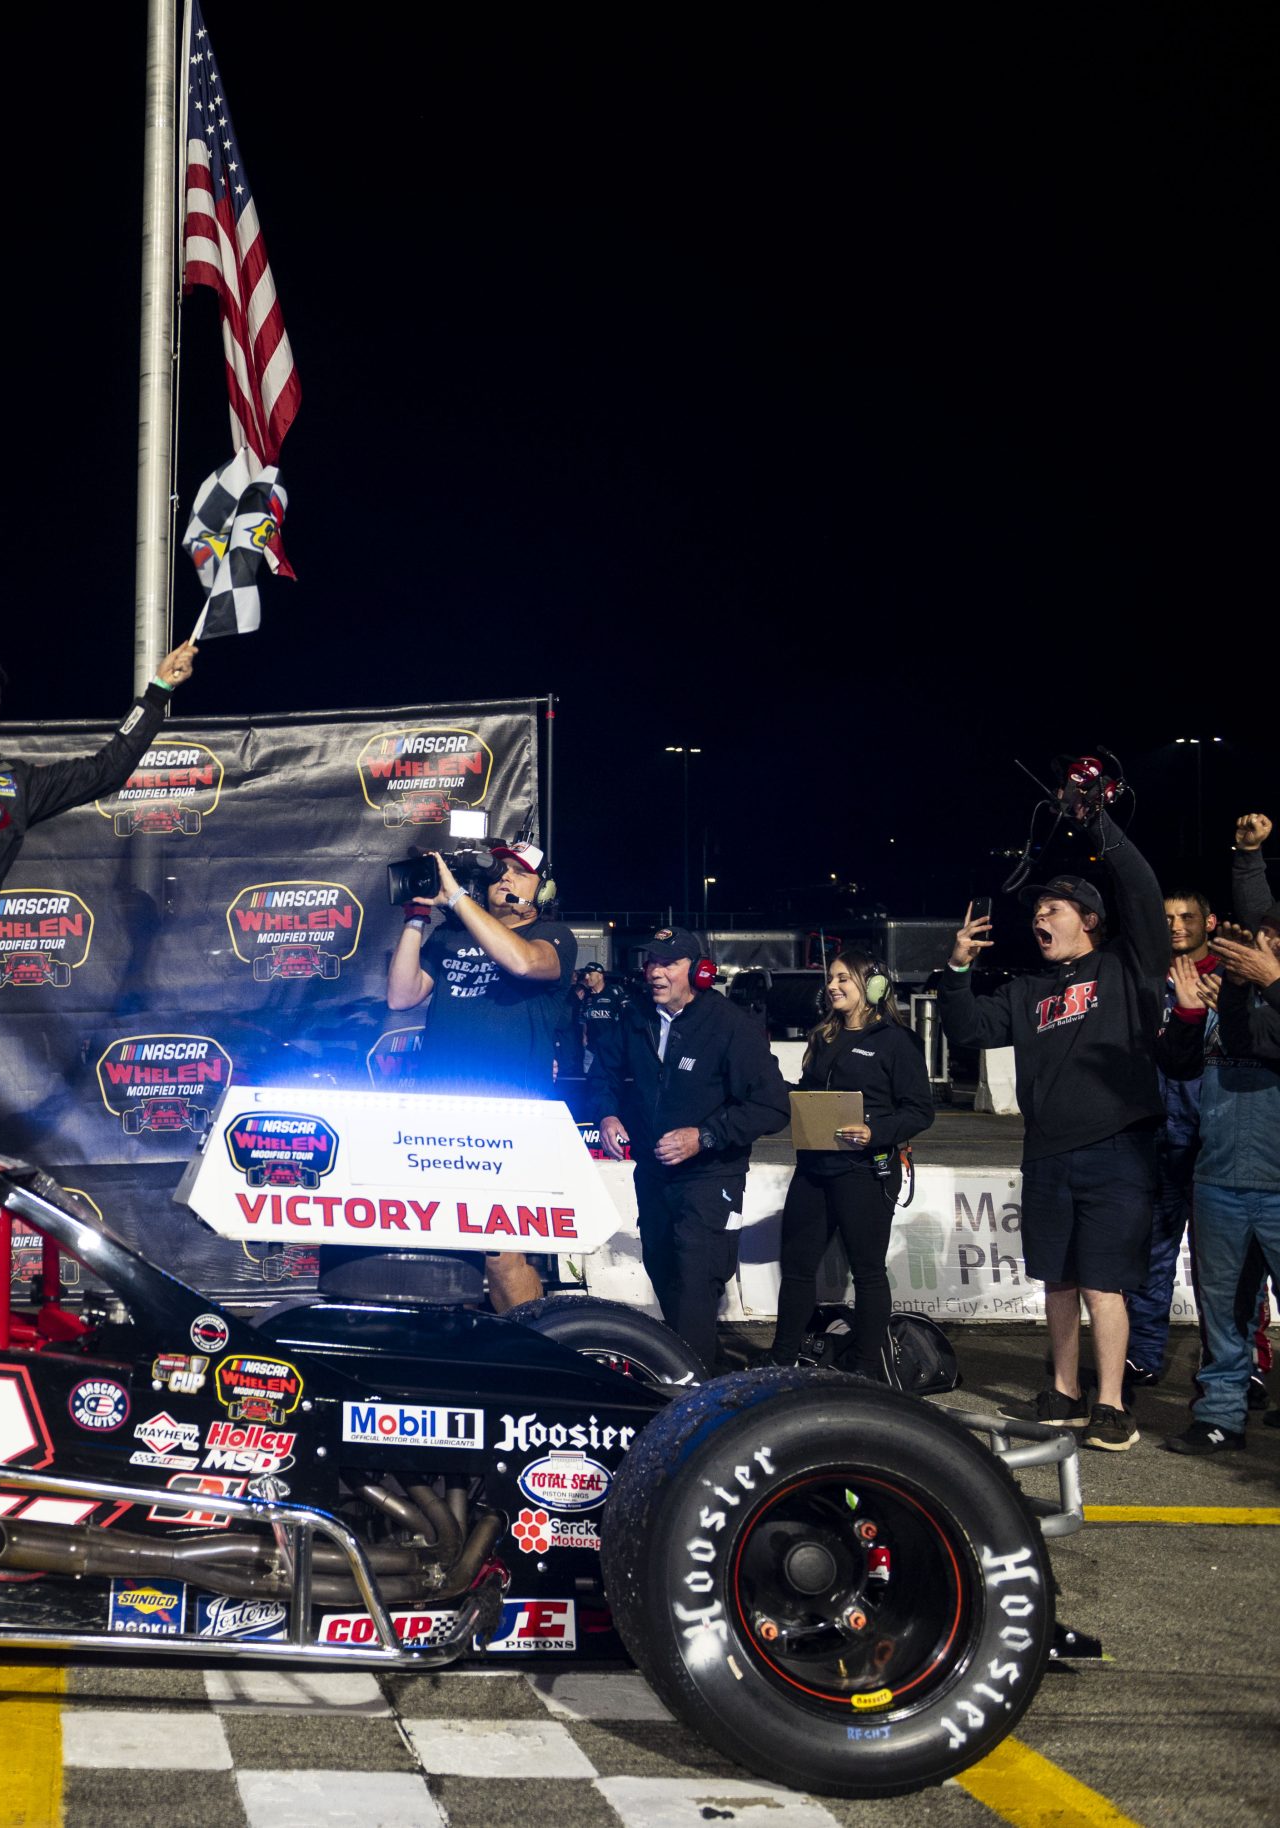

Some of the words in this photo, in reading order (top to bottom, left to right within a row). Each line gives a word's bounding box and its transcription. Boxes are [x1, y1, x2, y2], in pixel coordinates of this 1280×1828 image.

[401, 736, 469, 754] NASCAR
[367, 751, 482, 778] WHELEN
[387, 779, 437, 790] MODIFIED
[439, 777, 465, 788] TOUR
[119, 789, 167, 799] MODIFIED
[169, 788, 196, 797] TOUR
[4, 897, 70, 915] NASCAR
[272, 889, 339, 907] NASCAR
[235, 905, 352, 932] WHELEN
[40, 939, 66, 949] TOUR
[257, 932, 305, 943] MODIFIED
[307, 931, 334, 942] TOUR
[447, 972, 466, 983] OF
[451, 985, 487, 997] TIME
[141, 1042, 208, 1060] NASCAR
[104, 1058, 221, 1085] WHELEN
[127, 1086, 175, 1096] MODIFIED
[177, 1085, 204, 1095] TOUR
[263, 1120, 317, 1134] NASCAR
[233, 1131, 328, 1152] WHELEN
[393, 1130, 514, 1149] Jennerstown
[251, 1149, 290, 1159] MODIFIED
[292, 1151, 314, 1160] TOUR
[408, 1152, 503, 1174] Speedway
[235, 1192, 441, 1231] VICTORY
[457, 1202, 579, 1238] LANE
[892, 1298, 940, 1313] entral
[946, 1298, 978, 1315] City
[993, 1298, 1031, 1313] Park
[245, 1361, 289, 1377] NASCAR
[168, 1371, 206, 1394] CUP
[221, 1369, 297, 1394] WHELEN
[78, 1382, 122, 1401] NASCAR
[233, 1386, 266, 1398] MODIFIED
[266, 1391, 285, 1400] TOUR
[75, 1408, 123, 1427] SALUTES
[351, 1406, 436, 1437] Mobil
[136, 1427, 196, 1441] MAYHEW
[207, 1423, 294, 1457] Holley
[350, 1434, 379, 1442] OFFICIAL
[494, 1413, 635, 1451] Hoosier
[202, 1450, 280, 1473] MSD
[531, 1473, 567, 1489] TOTAL
[571, 1474, 602, 1491] SEAL
[551, 1521, 596, 1535] Serck
[551, 1535, 601, 1550] Motorsp
[673, 1446, 777, 1662] Hoosier
[120, 1594, 175, 1607] SUNOCO
[204, 1597, 280, 1636] Jostens
[506, 1640, 575, 1649] PISTONS
[940, 1545, 1040, 1750] Hoosier
